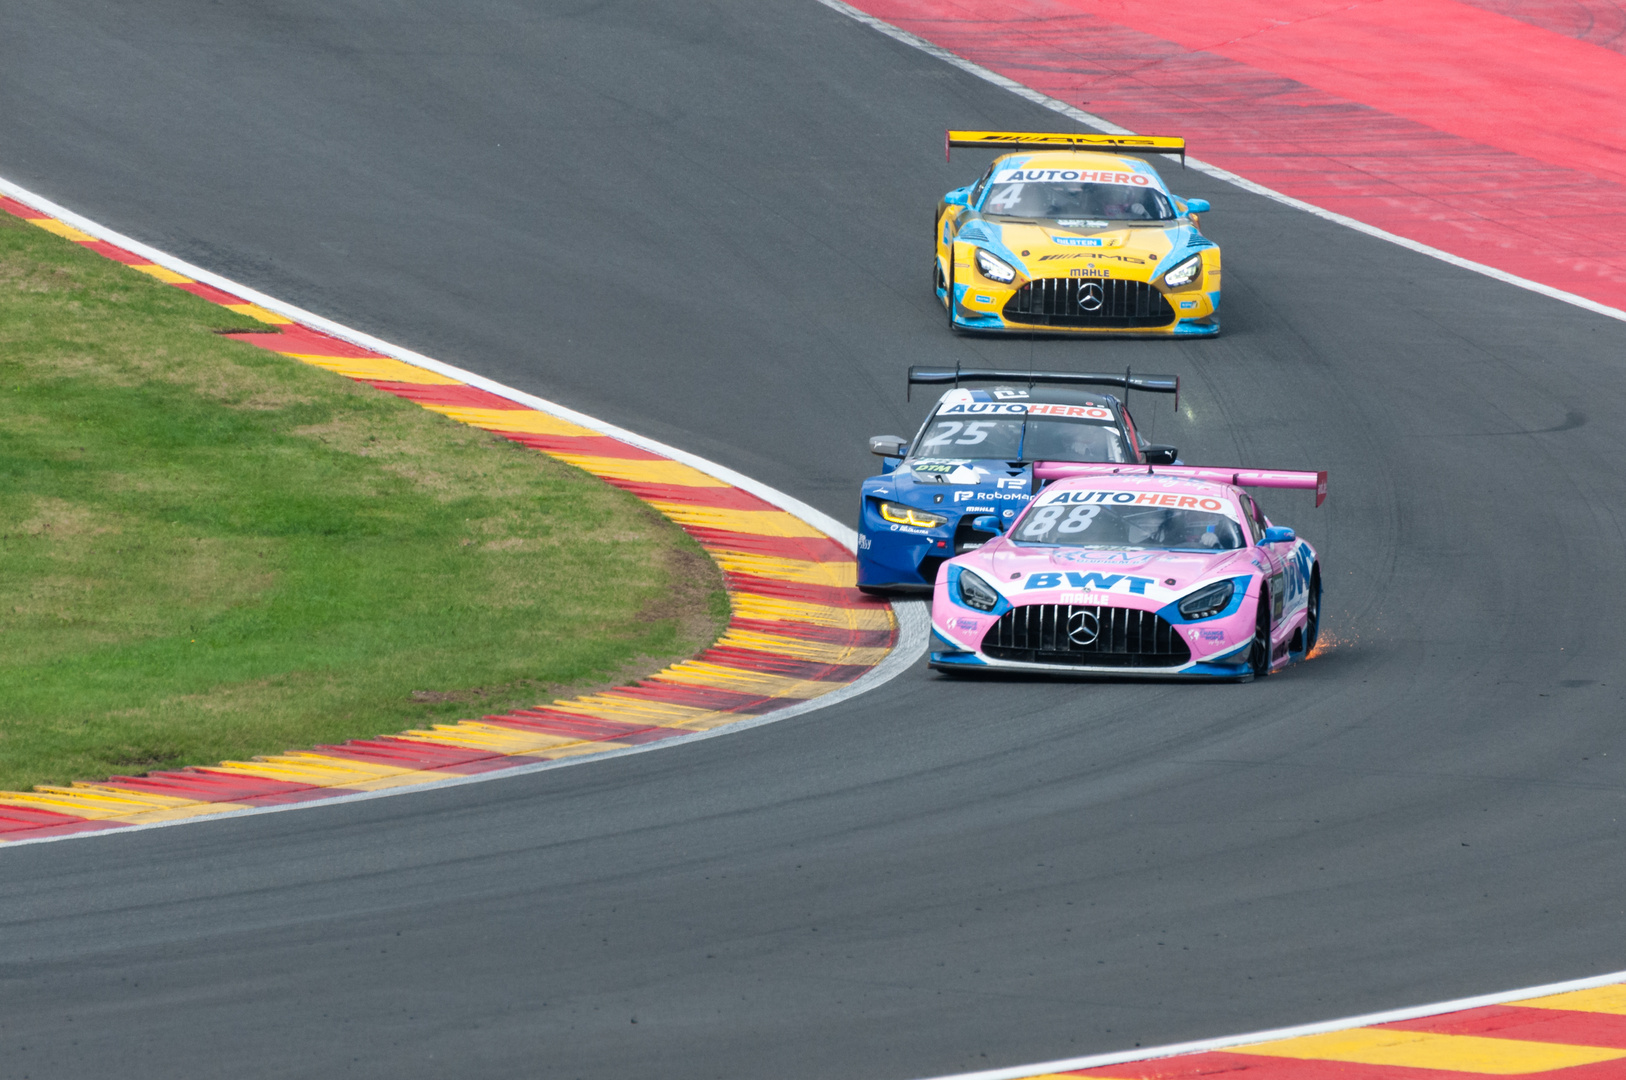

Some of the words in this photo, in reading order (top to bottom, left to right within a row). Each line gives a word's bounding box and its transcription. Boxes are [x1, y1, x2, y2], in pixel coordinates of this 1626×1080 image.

[1006, 170, 1149, 186] AUTOHERO
[990, 183, 1025, 209] 4
[1056, 238, 1098, 246] BILSTEIN
[1072, 252, 1146, 265] AMG
[1070, 268, 1110, 277] MAHLE
[946, 403, 1107, 418] AUTOHERO
[924, 420, 997, 446] 25
[916, 464, 952, 473] DTM
[965, 505, 994, 513] MAHLE
[1048, 491, 1222, 512] AUTOHERO
[1023, 504, 1101, 536] 88
[1023, 571, 1155, 595] BWT
[1060, 593, 1109, 606] MAHLE
